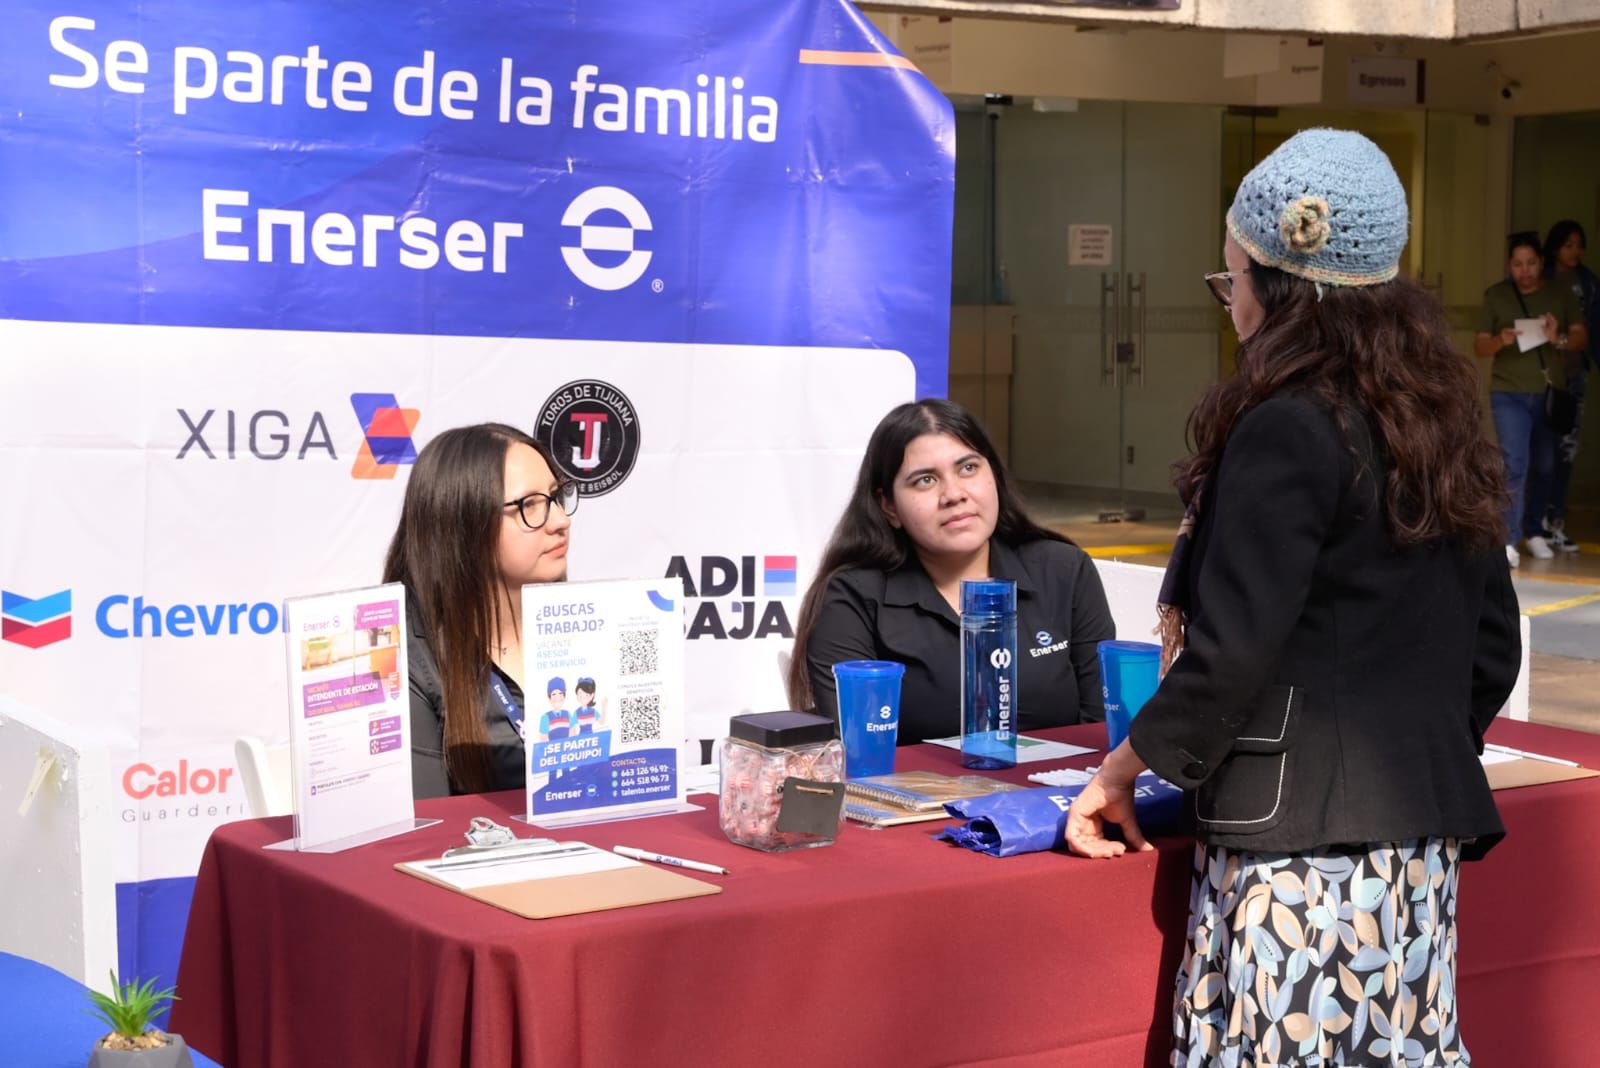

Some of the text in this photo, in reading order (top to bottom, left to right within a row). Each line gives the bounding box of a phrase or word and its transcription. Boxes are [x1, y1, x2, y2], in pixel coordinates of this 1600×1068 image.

[49, 15, 779, 143] Se parte de la familia
[1358, 73, 1407, 89] Egresos
[202, 188, 524, 274] Enerser
[541, 385, 634, 428] TOROS DE TIJUANA
[175, 408, 339, 461] XIGA
[588, 470, 623, 493] BEISBOL
[664, 555, 756, 597] ADI
[95, 594, 288, 639] Chevro
[535, 602, 595, 621] ¿BUSCAS
[683, 600, 796, 640] AJA
[536, 619, 605, 636] TRABAJO?
[1030, 639, 1069, 658] Enerser
[996, 676, 1010, 741] Enerser
[539, 747, 602, 767] DEL EQUIPO!
[544, 737, 599, 757] ¡SE PARTE
[611, 757, 647, 767] CONTACTO
[122, 759, 233, 800] Calor
[545, 789, 582, 802] Enerser
